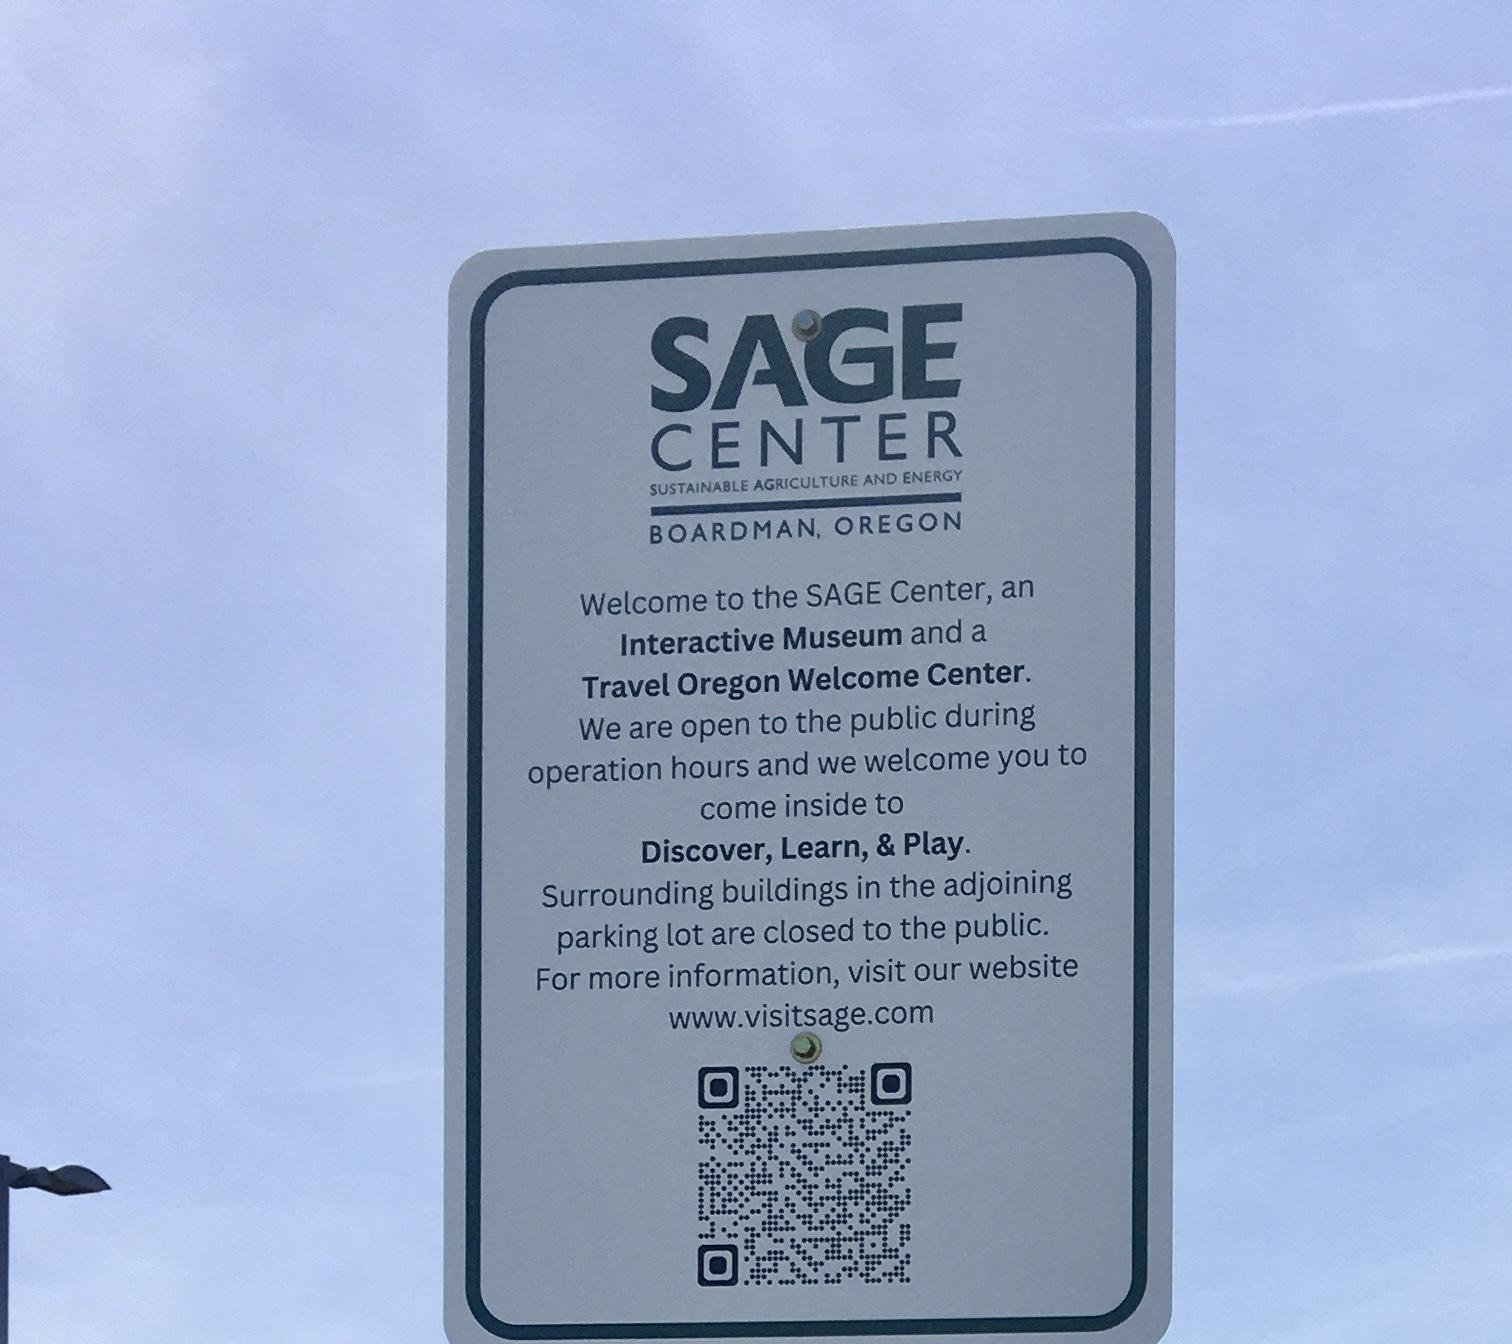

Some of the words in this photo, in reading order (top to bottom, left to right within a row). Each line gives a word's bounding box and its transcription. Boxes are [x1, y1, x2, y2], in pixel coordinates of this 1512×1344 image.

[651, 303, 962, 412] SAGE
[651, 411, 962, 471] CENTER
[650, 480, 748, 496] SUSTAINABLE
[754, 475, 857, 491] AGRICULTURE
[863, 473, 897, 485] AND
[903, 470, 962, 484] ENERGY
[650, 518, 820, 544] BOARDMAN,
[835, 511, 960, 535] OREGON
[581, 591, 707, 616] Welcome
[716, 590, 743, 611] to
[752, 585, 797, 609] the
[807, 581, 881, 607] SAGE
[891, 580, 992, 605] Center,
[1002, 580, 1033, 598] an
[622, 628, 774, 656] Interactive
[784, 627, 901, 649] Museum
[911, 619, 961, 645] and
[972, 624, 987, 642] a
[582, 673, 669, 698] Travel
[678, 673, 779, 700] Oregon
[788, 666, 919, 691] Welcome
[928, 663, 1030, 686] Center.
[579, 718, 620, 740] We
[630, 721, 672, 739] are
[681, 718, 749, 743] open
[759, 714, 787, 734] to
[796, 709, 841, 733] the
[851, 705, 936, 737] public
[946, 702, 1035, 731] during
[529, 758, 661, 789] operation
[672, 756, 749, 779] hours
[758, 751, 808, 776] and
[818, 756, 856, 774] we
[864, 748, 989, 772] welcome
[998, 749, 1048, 775] you
[1058, 745, 1086, 765] to
[701, 801, 776, 820] come
[786, 792, 866, 817] inside
[875, 794, 903, 814] to
[643, 839, 772, 865] Discover,
[782, 837, 868, 862] Learn,
[877, 833, 895, 856] &
[905, 831, 970, 861] Play.
[542, 881, 713, 910] Surrounding
[723, 877, 848, 907] buildings
[858, 875, 880, 899] in
[889, 874, 935, 898] the
[944, 870, 1072, 902] adjoining
[558, 924, 658, 955] parking
[668, 923, 703, 946] lot
[712, 927, 755, 945] are
[764, 918, 853, 943] closed
[863, 920, 891, 941] to
[900, 916, 945, 940] the
[956, 912, 1048, 944] public.
[537, 968, 580, 991] For
[590, 971, 659, 989] more
[669, 961, 839, 989] information,
[848, 959, 906, 983] visit
[915, 963, 961, 981] our
[970, 954, 1078, 979] website
[669, 1003, 933, 1032] www.visitsage.com
